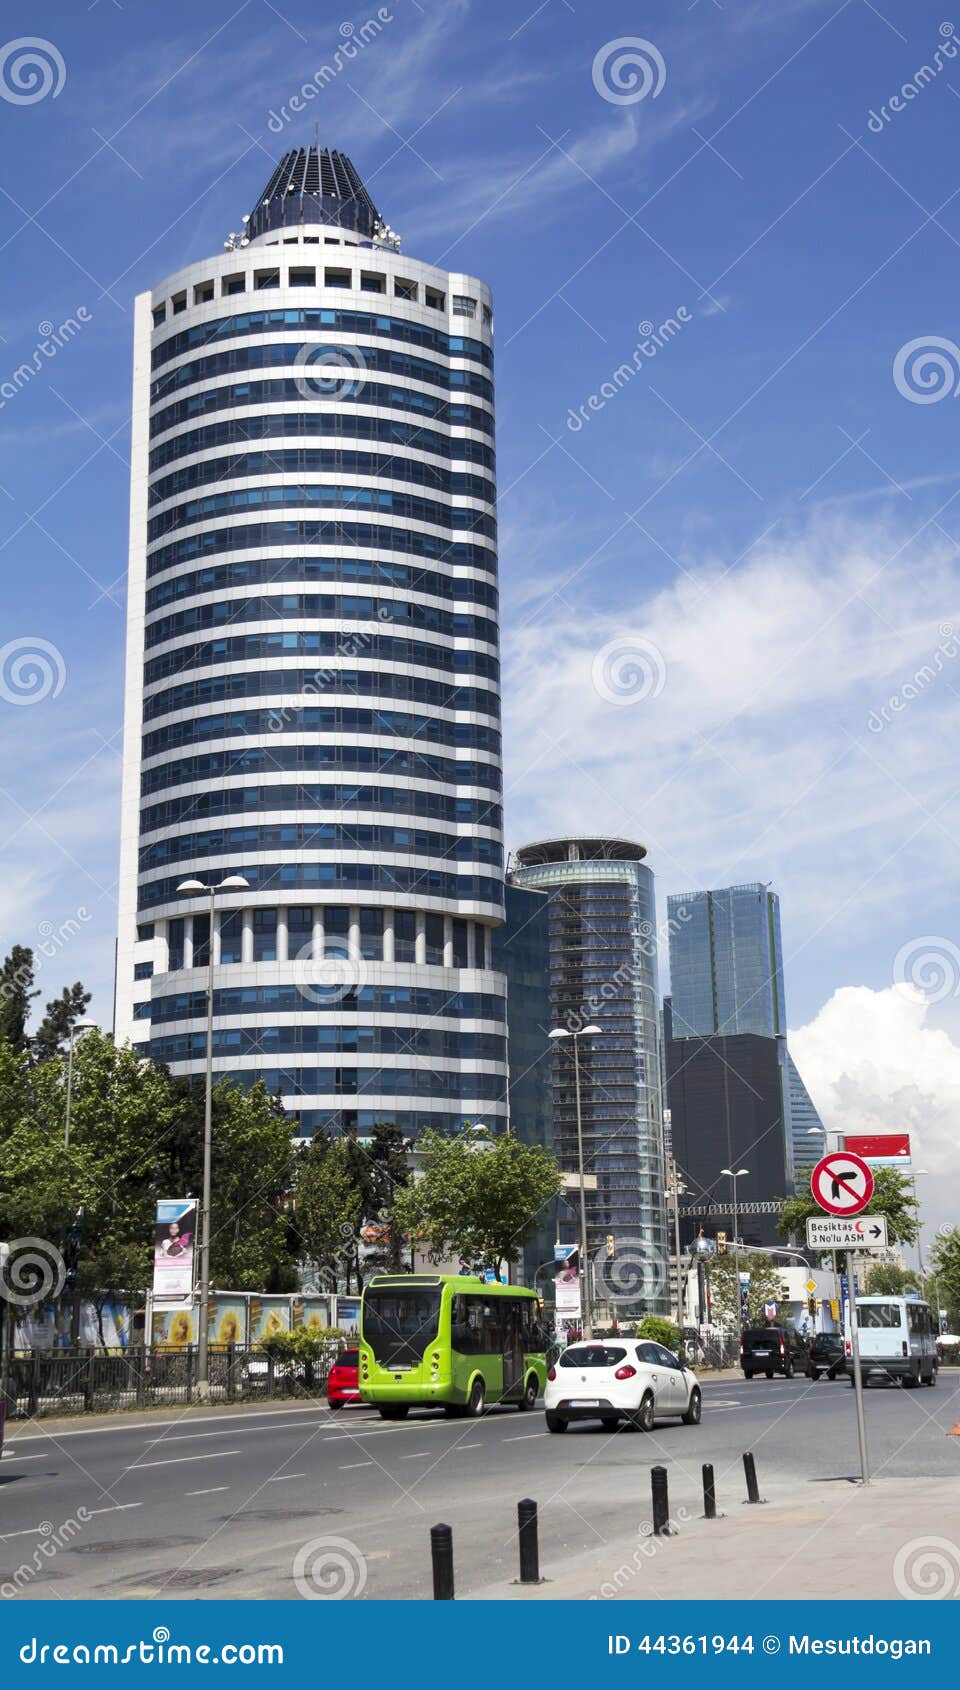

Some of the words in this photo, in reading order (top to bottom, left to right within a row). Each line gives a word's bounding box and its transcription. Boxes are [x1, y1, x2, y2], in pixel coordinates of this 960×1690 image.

[811, 1222, 853, 1232] Beşiktaş
[812, 1234, 818, 1243] 3
[819, 1233, 841, 1243] No'lu
[844, 1233, 865, 1242] ASM
